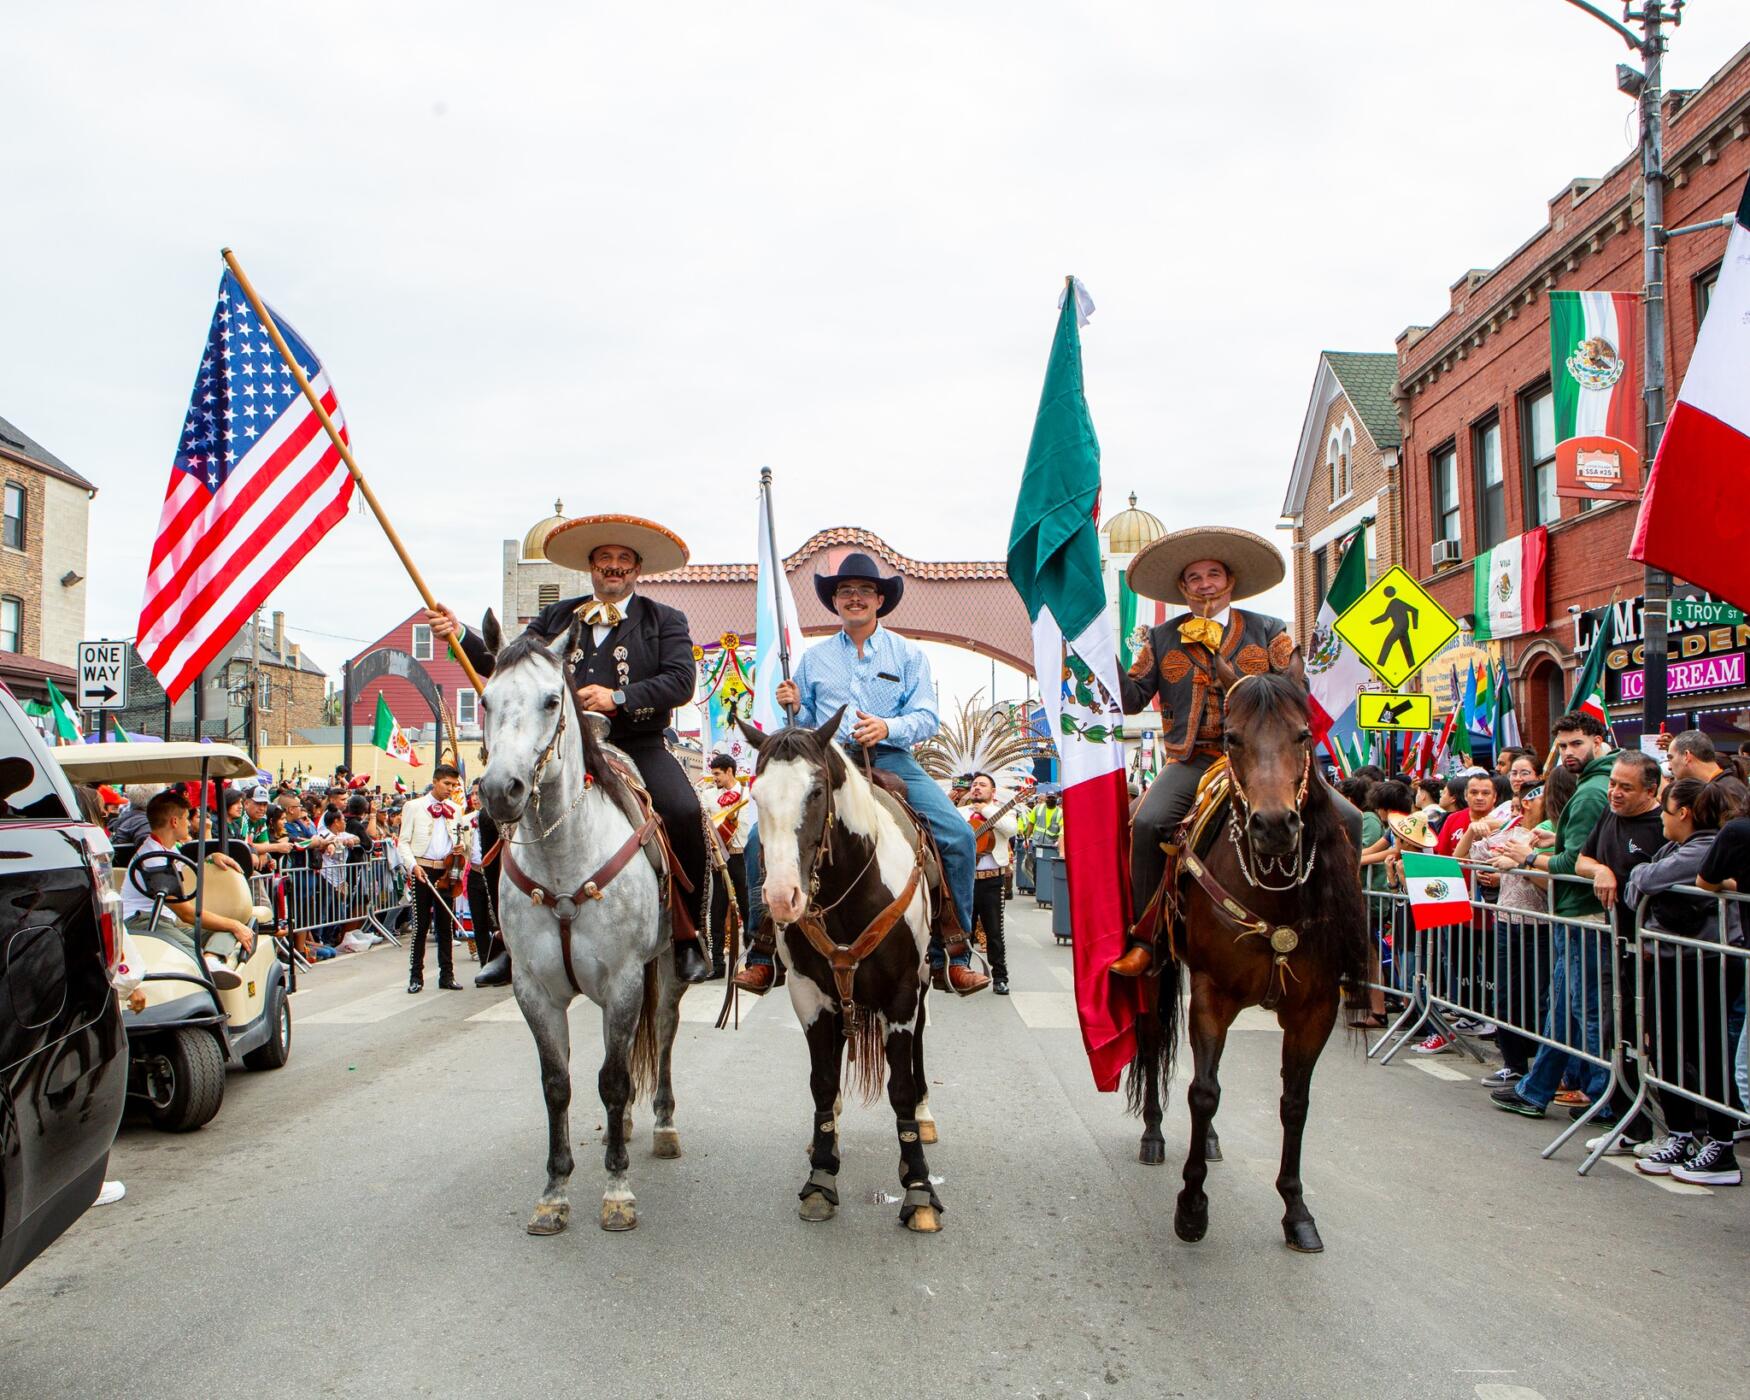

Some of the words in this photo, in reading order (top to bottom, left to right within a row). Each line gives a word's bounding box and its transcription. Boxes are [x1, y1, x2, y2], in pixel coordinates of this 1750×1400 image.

[1676, 606, 1683, 615] S
[1686, 603, 1722, 620] TROY
[1727, 609, 1737, 619] ST
[85, 647, 120, 663] ONE
[83, 666, 120, 681] WAY
[1623, 673, 1644, 698] IC
